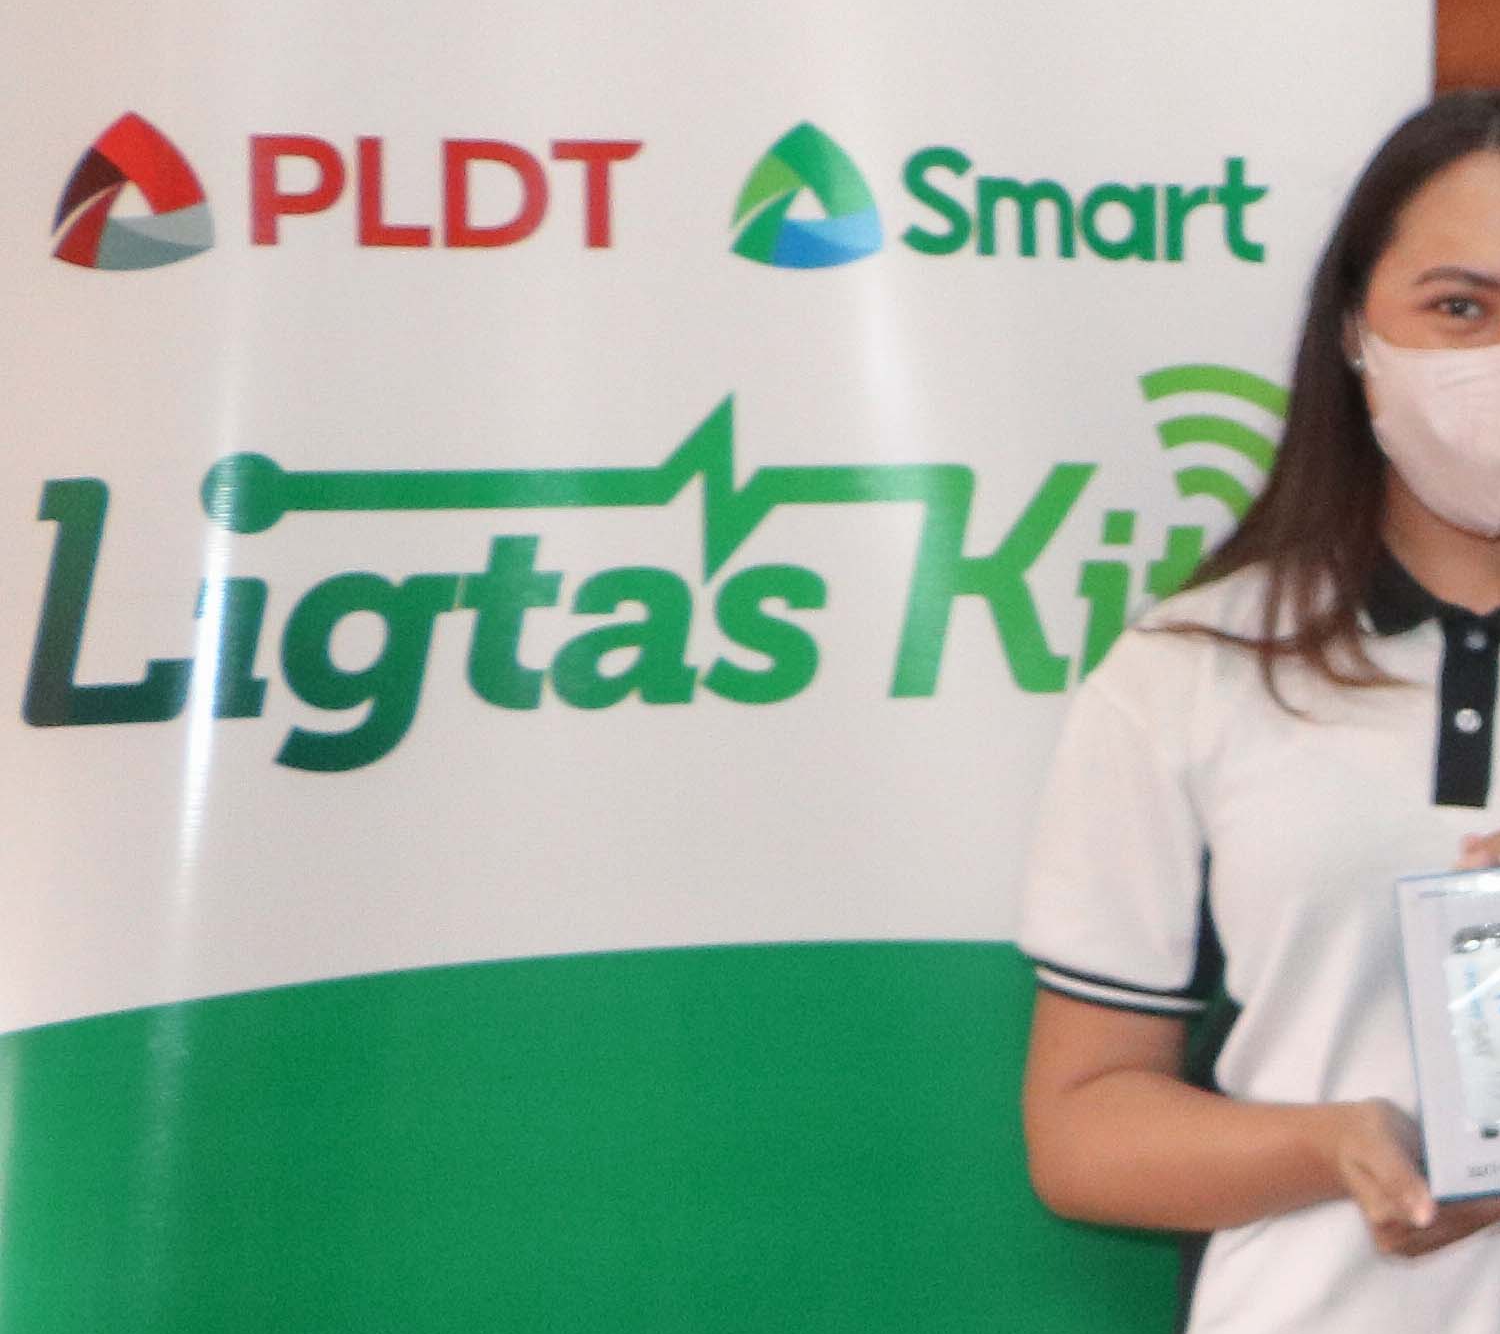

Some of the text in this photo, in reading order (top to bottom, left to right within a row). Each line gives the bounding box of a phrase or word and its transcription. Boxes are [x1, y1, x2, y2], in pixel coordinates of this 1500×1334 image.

[246, 132, 1272, 264] PLDT Smart
[22, 452, 829, 774] Ligtas
